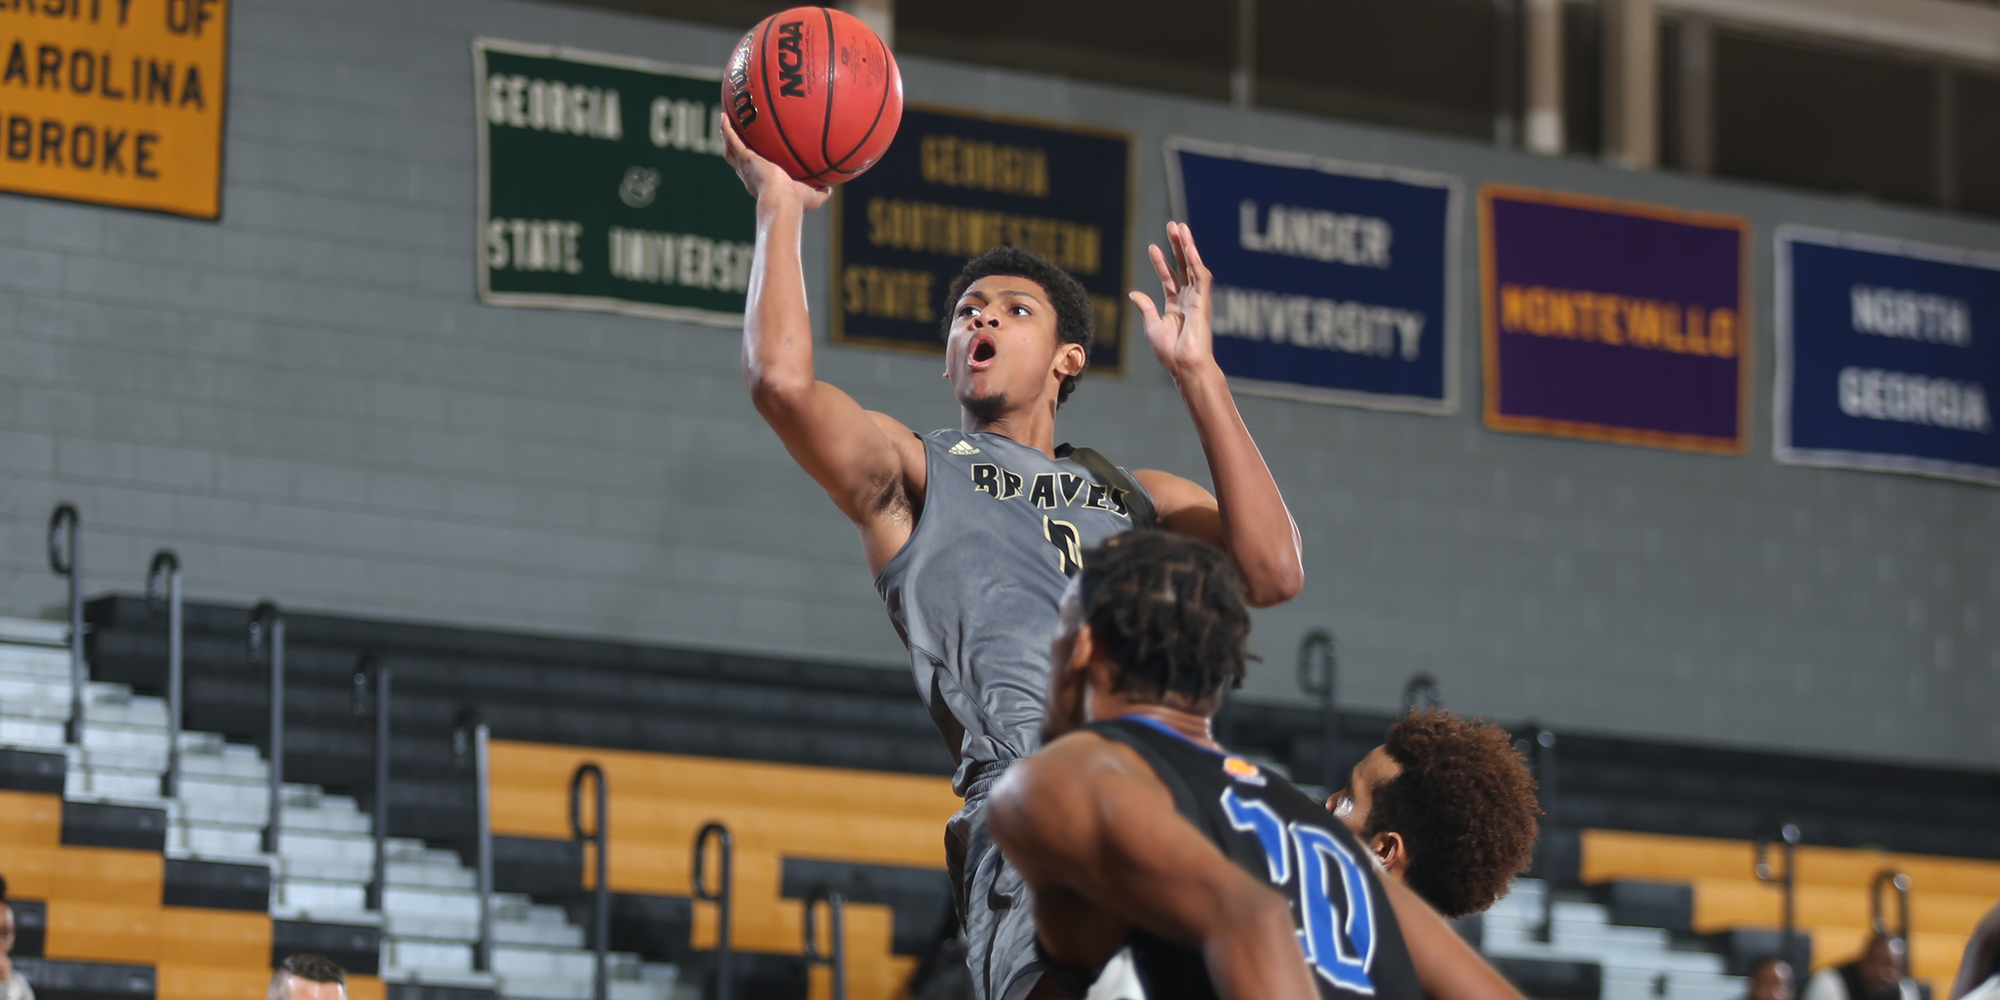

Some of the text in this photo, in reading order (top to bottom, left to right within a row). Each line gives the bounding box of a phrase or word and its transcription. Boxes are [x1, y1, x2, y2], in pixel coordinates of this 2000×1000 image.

[165, 0, 214, 37] OF
[4, 38, 206, 113] AROLINA
[779, 21, 805, 98] NCAA
[488, 73, 623, 140] GEORGIA
[0, 112, 161, 179] BROKE
[920, 135, 1049, 197] GEORGIA
[488, 217, 754, 294] STATE UNIVERSI
[1239, 199, 1393, 270] LANDER
[844, 265, 935, 322] STATE
[1501, 283, 1737, 360] MONTEVALLO
[1850, 283, 1973, 347] NORTH
[1838, 366, 1992, 433] GEORGIA
[971, 463, 1130, 518] BRAVES
